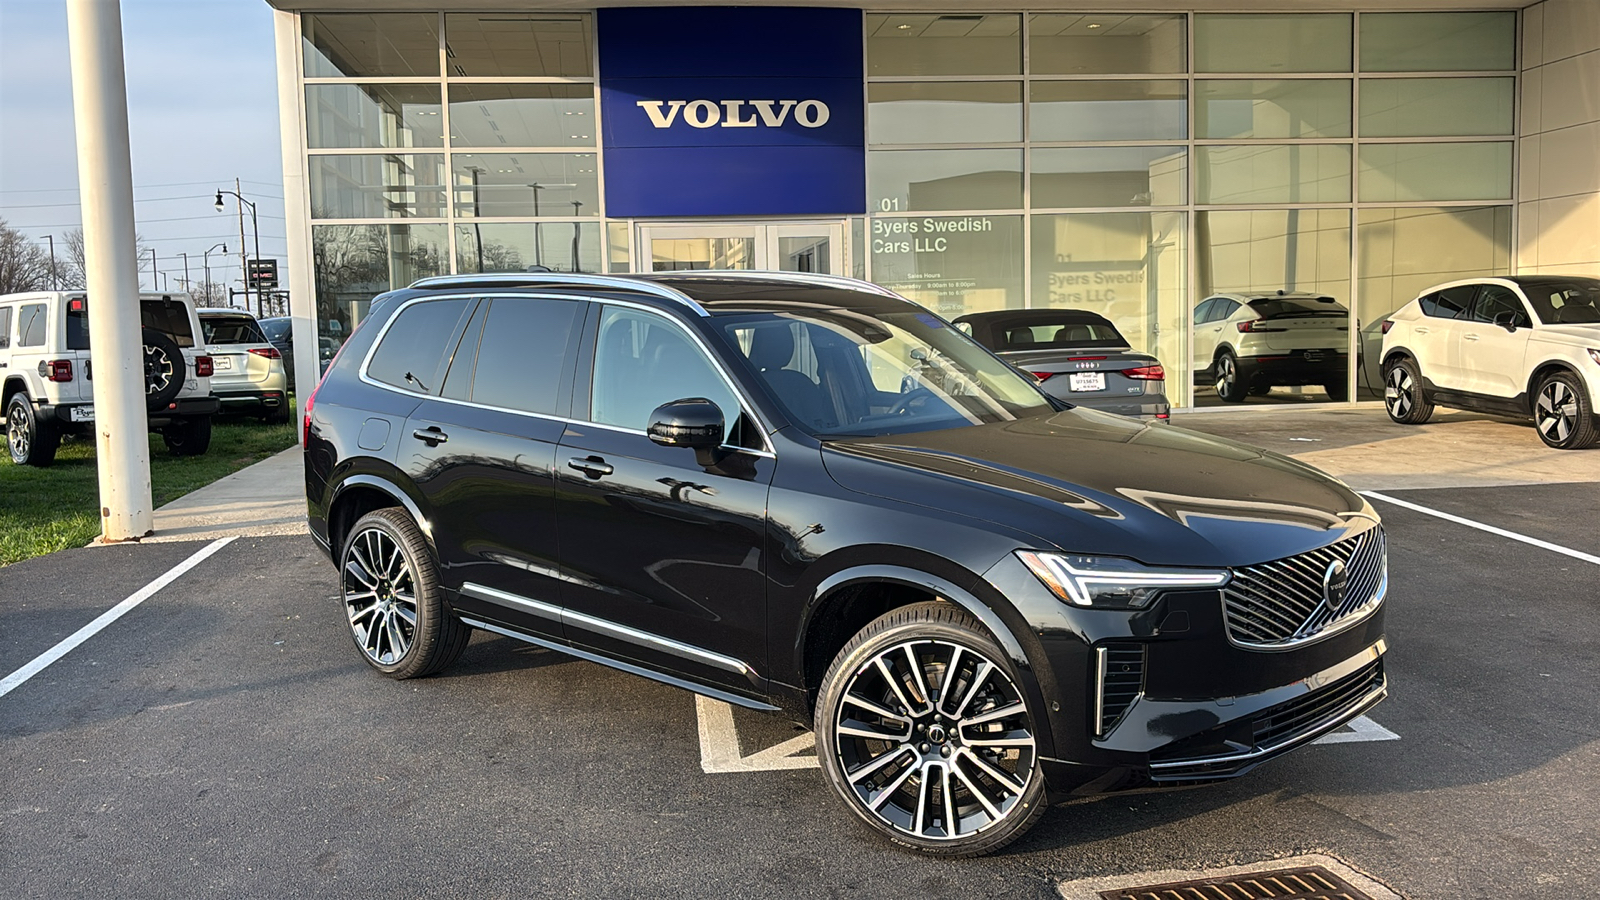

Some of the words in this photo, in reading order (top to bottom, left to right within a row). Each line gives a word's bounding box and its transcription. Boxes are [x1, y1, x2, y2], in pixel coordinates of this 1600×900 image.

[636, 99, 830, 129] VOLVO
[874, 220, 918, 237] Byers
[923, 217, 992, 233] Swedish
[873, 239, 910, 254] Cars
[915, 237, 947, 253] LLC
[1086, 289, 1116, 303] LLC
